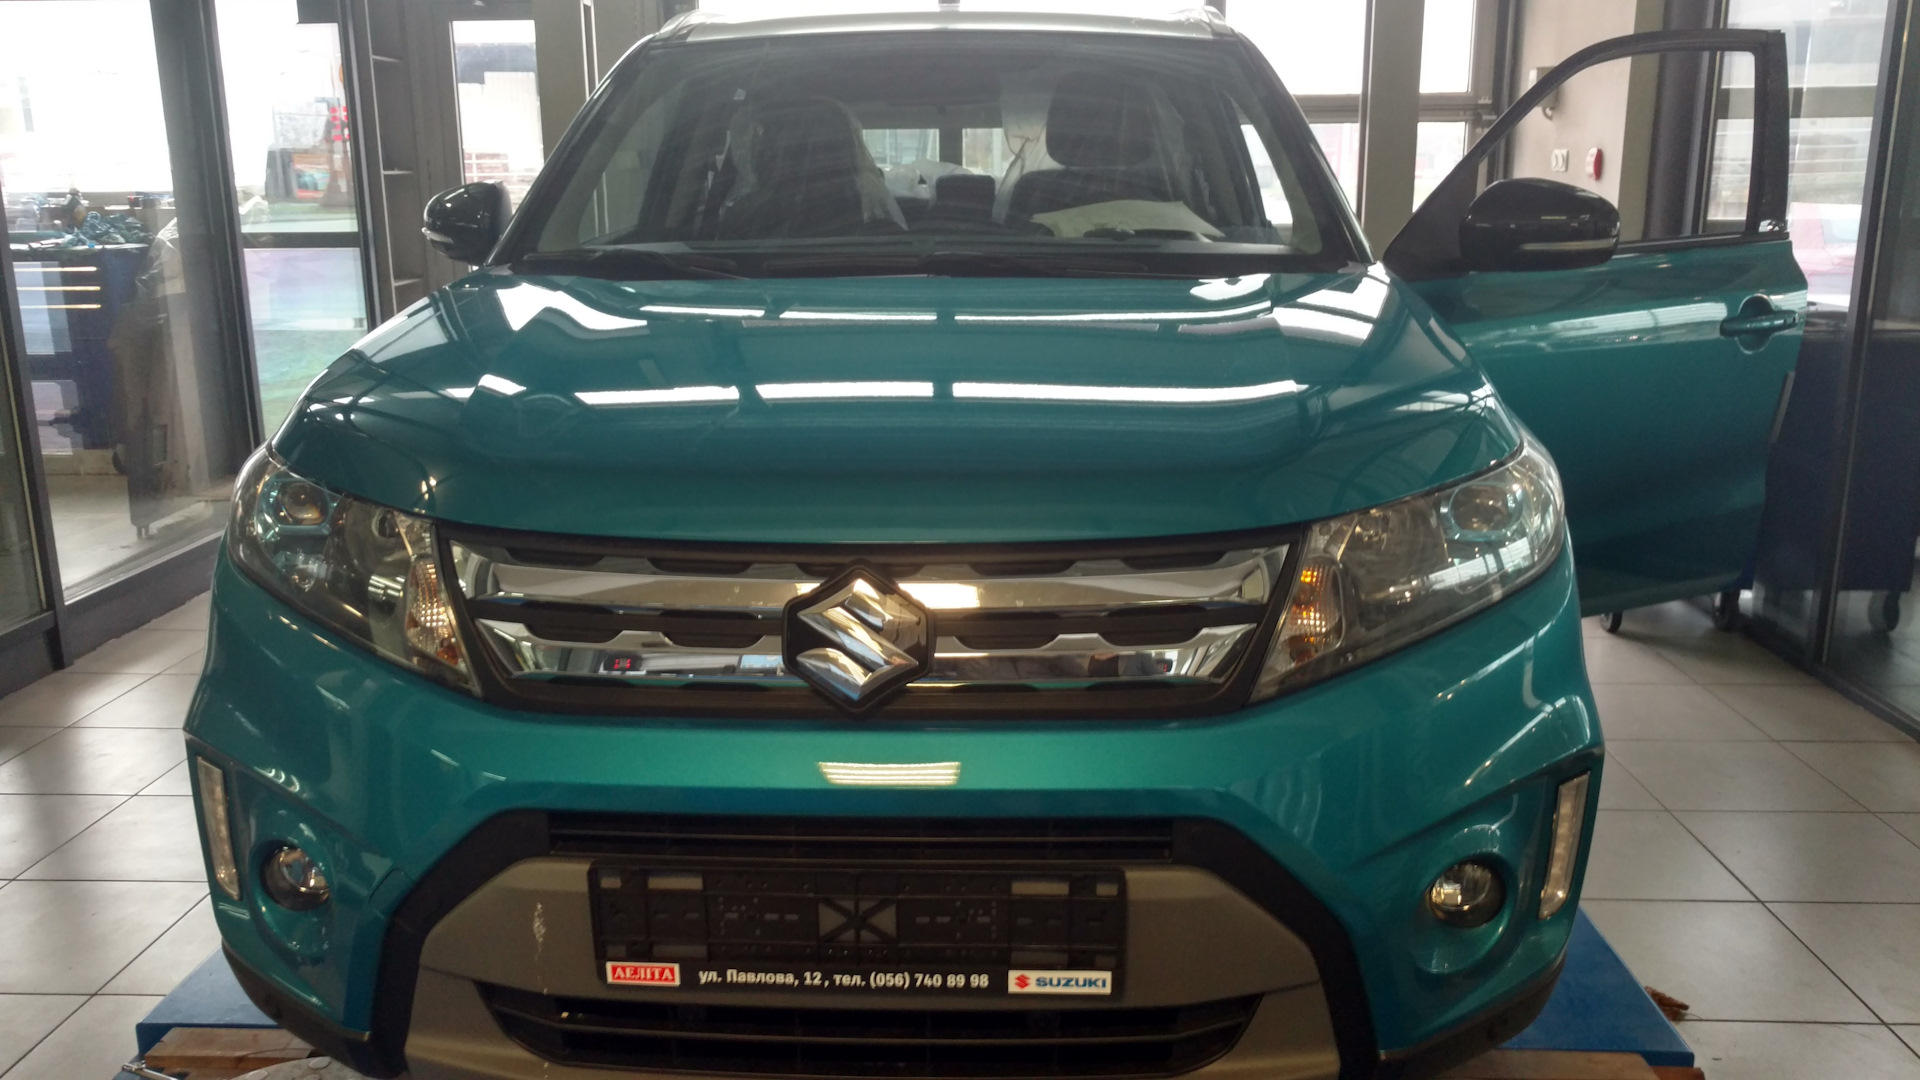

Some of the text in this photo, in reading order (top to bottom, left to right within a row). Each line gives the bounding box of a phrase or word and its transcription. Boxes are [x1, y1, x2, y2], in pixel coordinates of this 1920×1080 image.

[698, 968, 990, 990] ул. Павлова, 12, тел. (056) 740 89 98
[1035, 976, 1107, 989] SUZUKI
